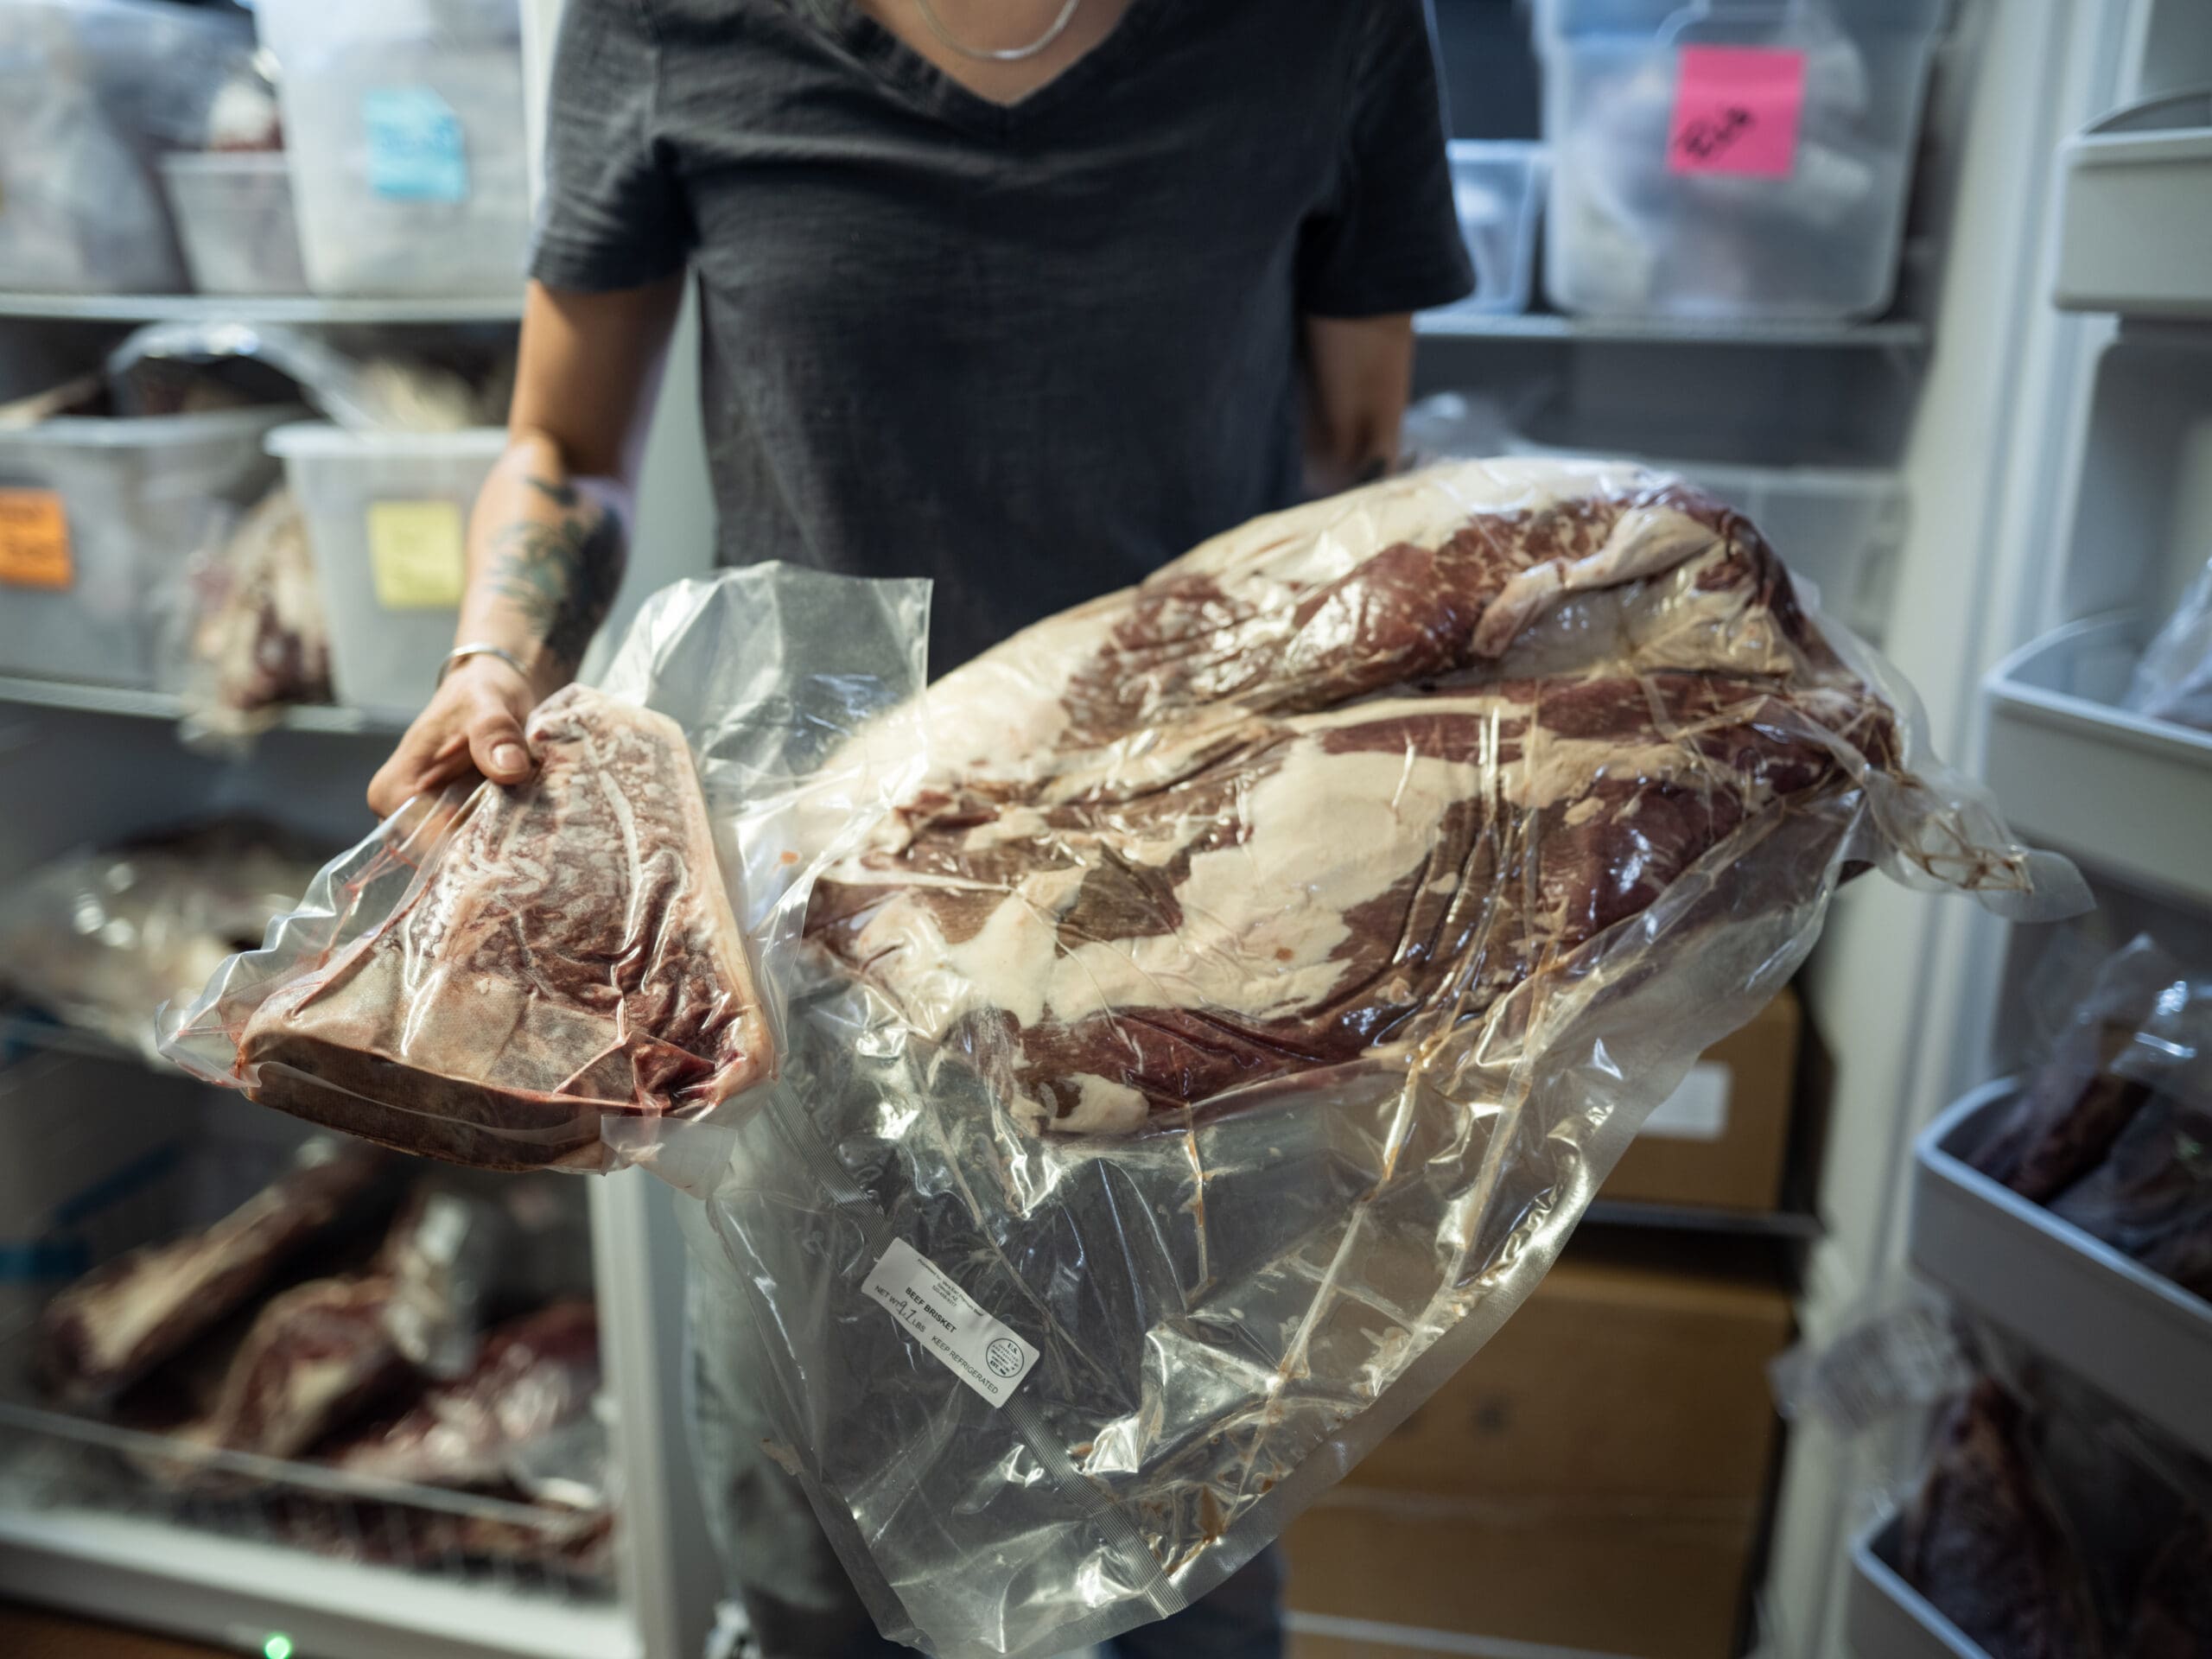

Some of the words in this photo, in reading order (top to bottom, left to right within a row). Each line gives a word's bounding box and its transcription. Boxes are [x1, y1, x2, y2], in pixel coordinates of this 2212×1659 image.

[874, 1285, 891, 1298] NET
[912, 1319, 926, 1332] LBS
[905, 1287, 925, 1306] BEEF
[924, 1304, 957, 1333] BRISKET
[931, 1335, 950, 1352] KEEP
[950, 1351, 999, 1394] REFRIGERATED
